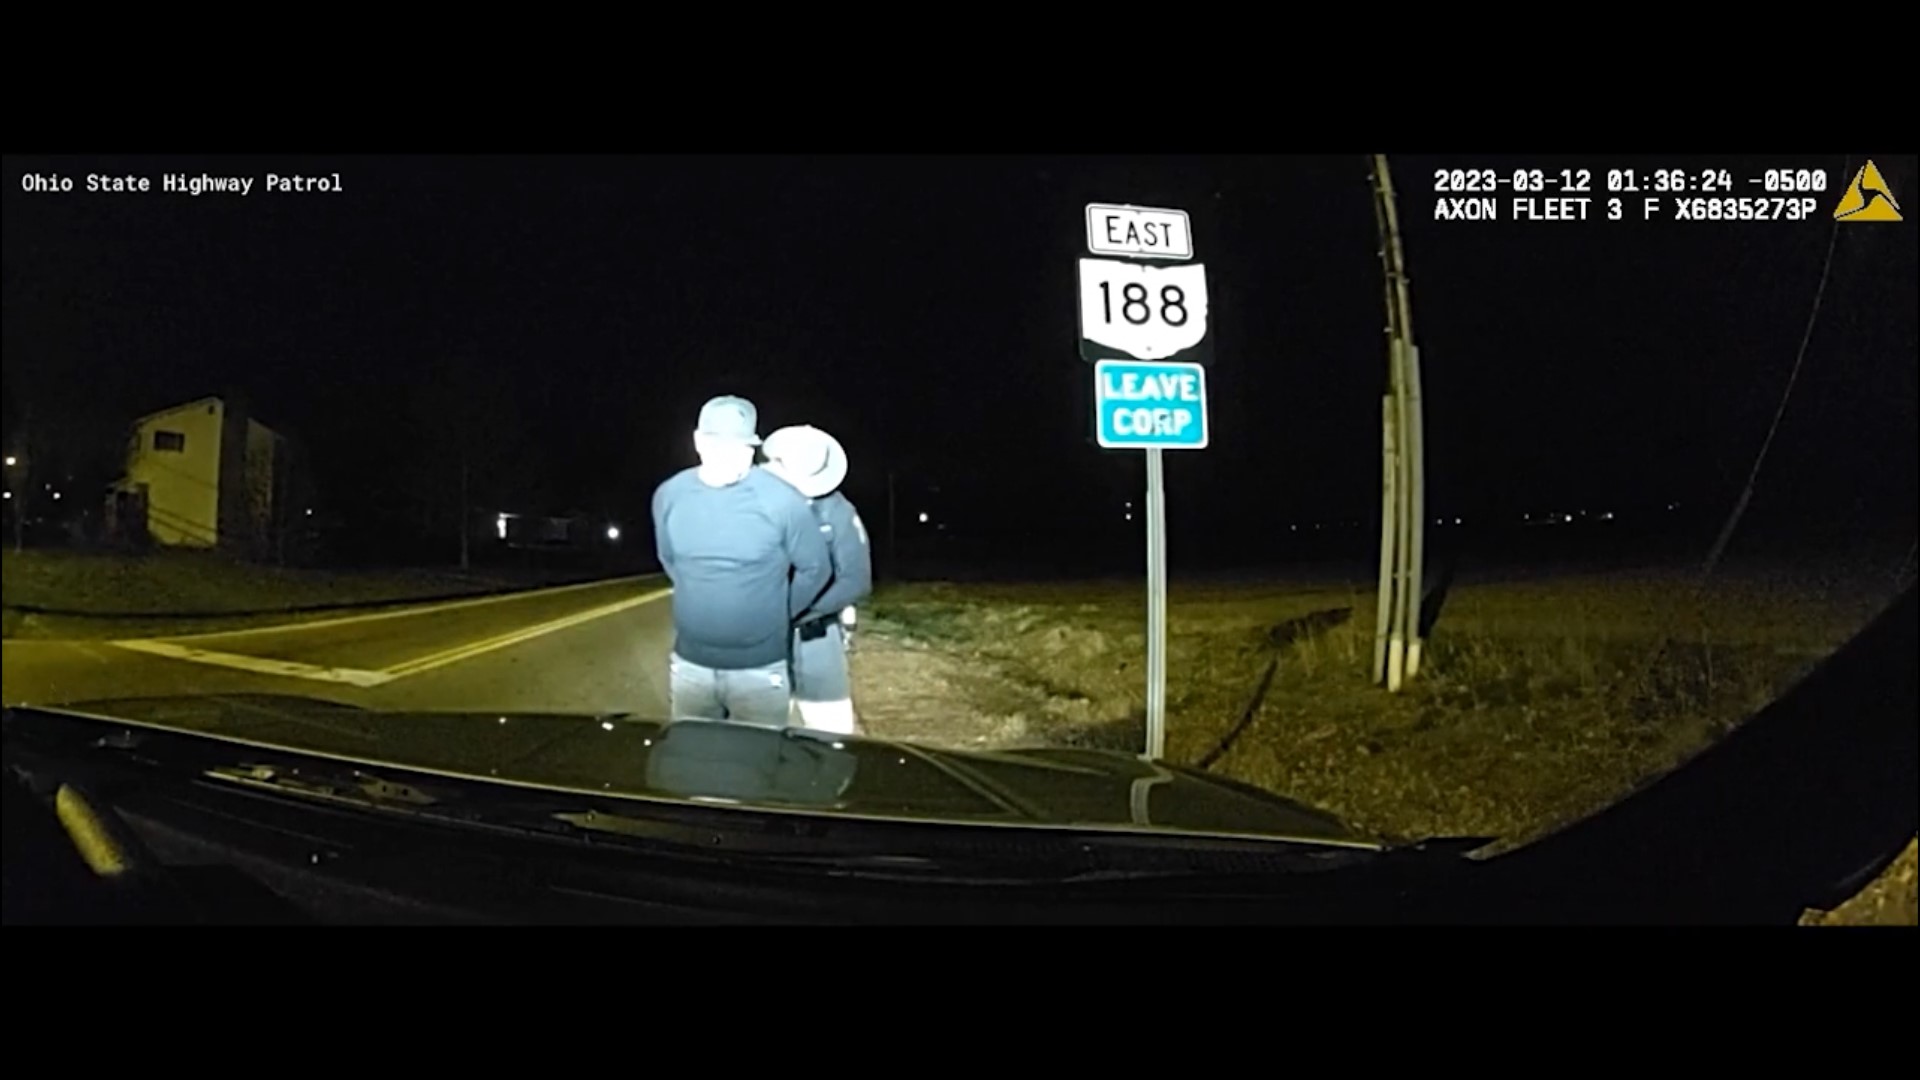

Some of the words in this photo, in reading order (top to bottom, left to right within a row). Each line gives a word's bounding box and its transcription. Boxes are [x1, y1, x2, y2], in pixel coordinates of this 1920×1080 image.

[1105, 215, 1171, 248] EAST
[1099, 280, 1188, 327] 188
[1102, 372, 1199, 402] LEAVE
[1112, 407, 1193, 437] CORP
